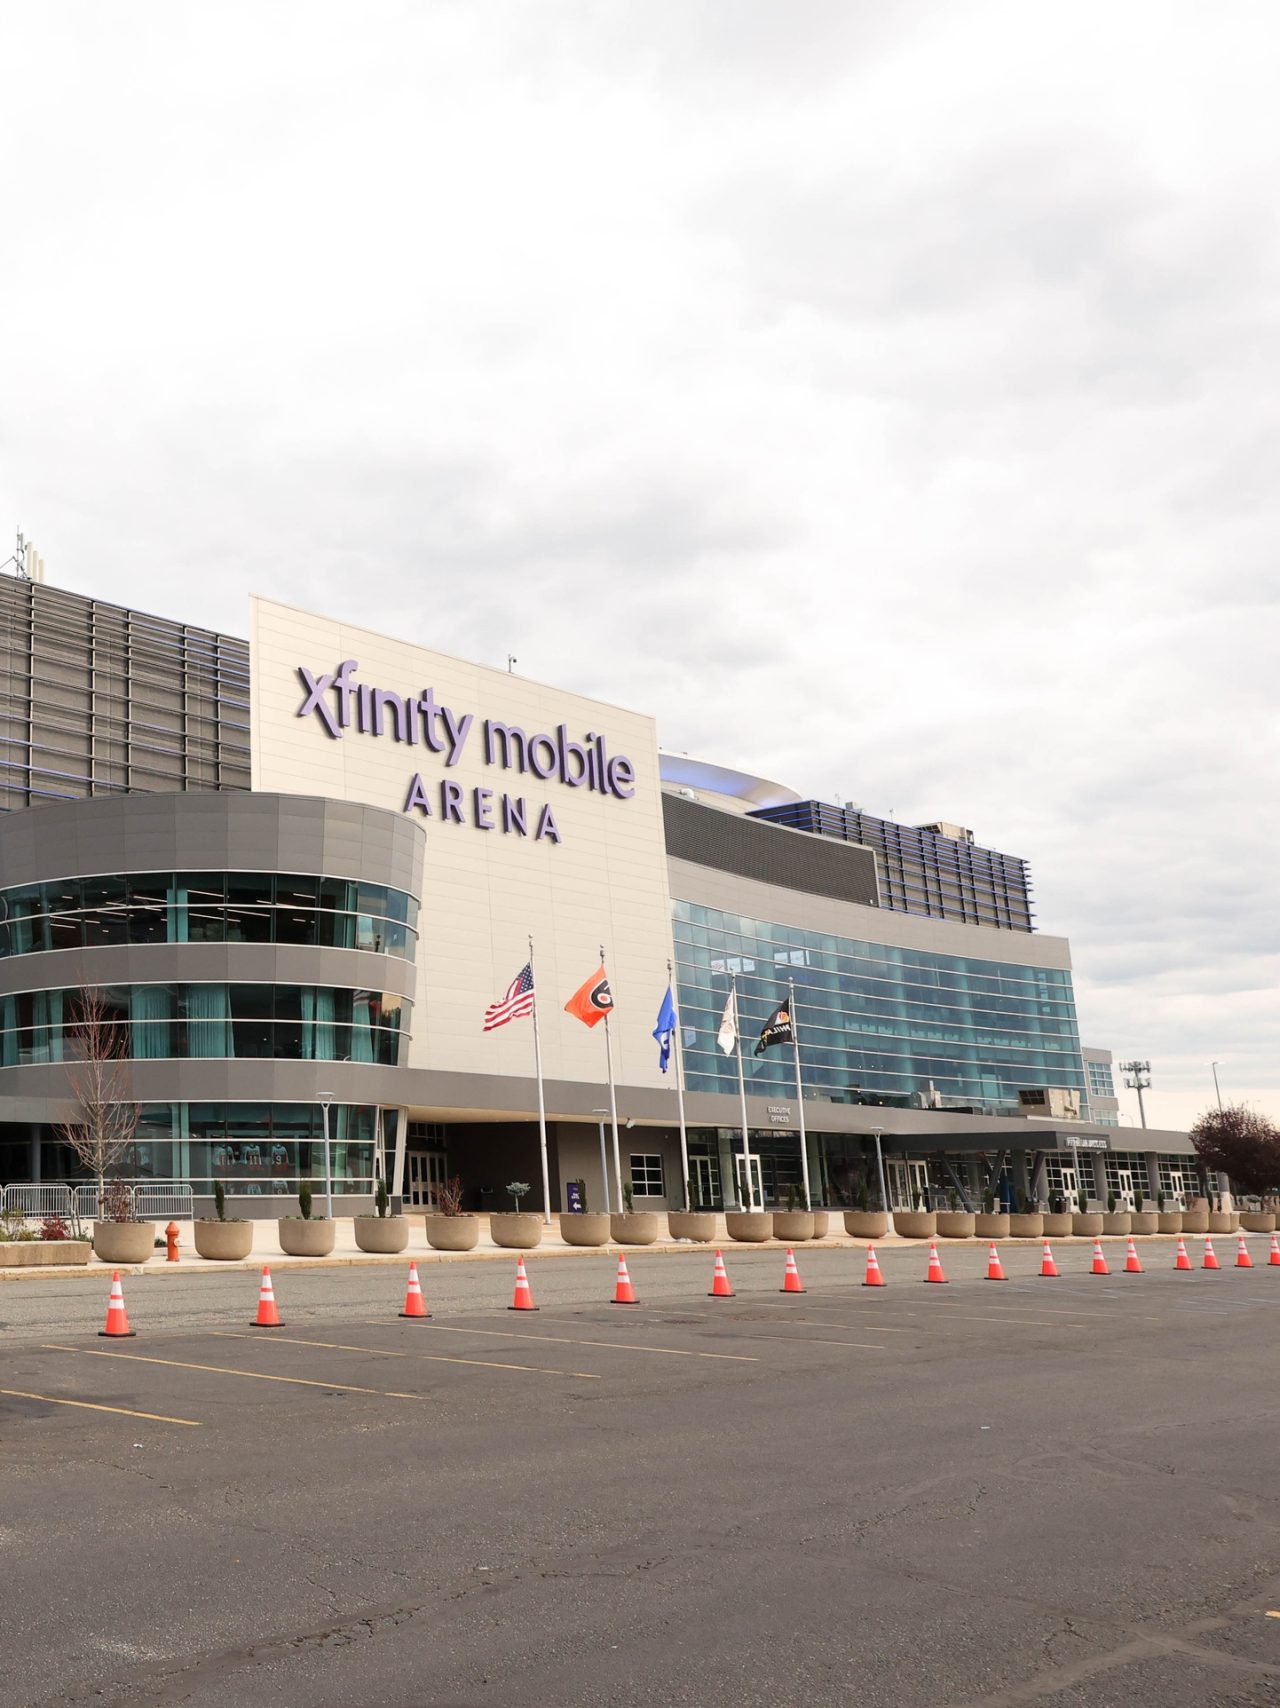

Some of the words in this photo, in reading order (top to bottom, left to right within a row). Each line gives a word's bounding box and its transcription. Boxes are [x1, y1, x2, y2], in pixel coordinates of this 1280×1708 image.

[297, 659, 474, 768] xfinity
[484, 719, 635, 799] mobile
[404, 772, 562, 844] ARENA
